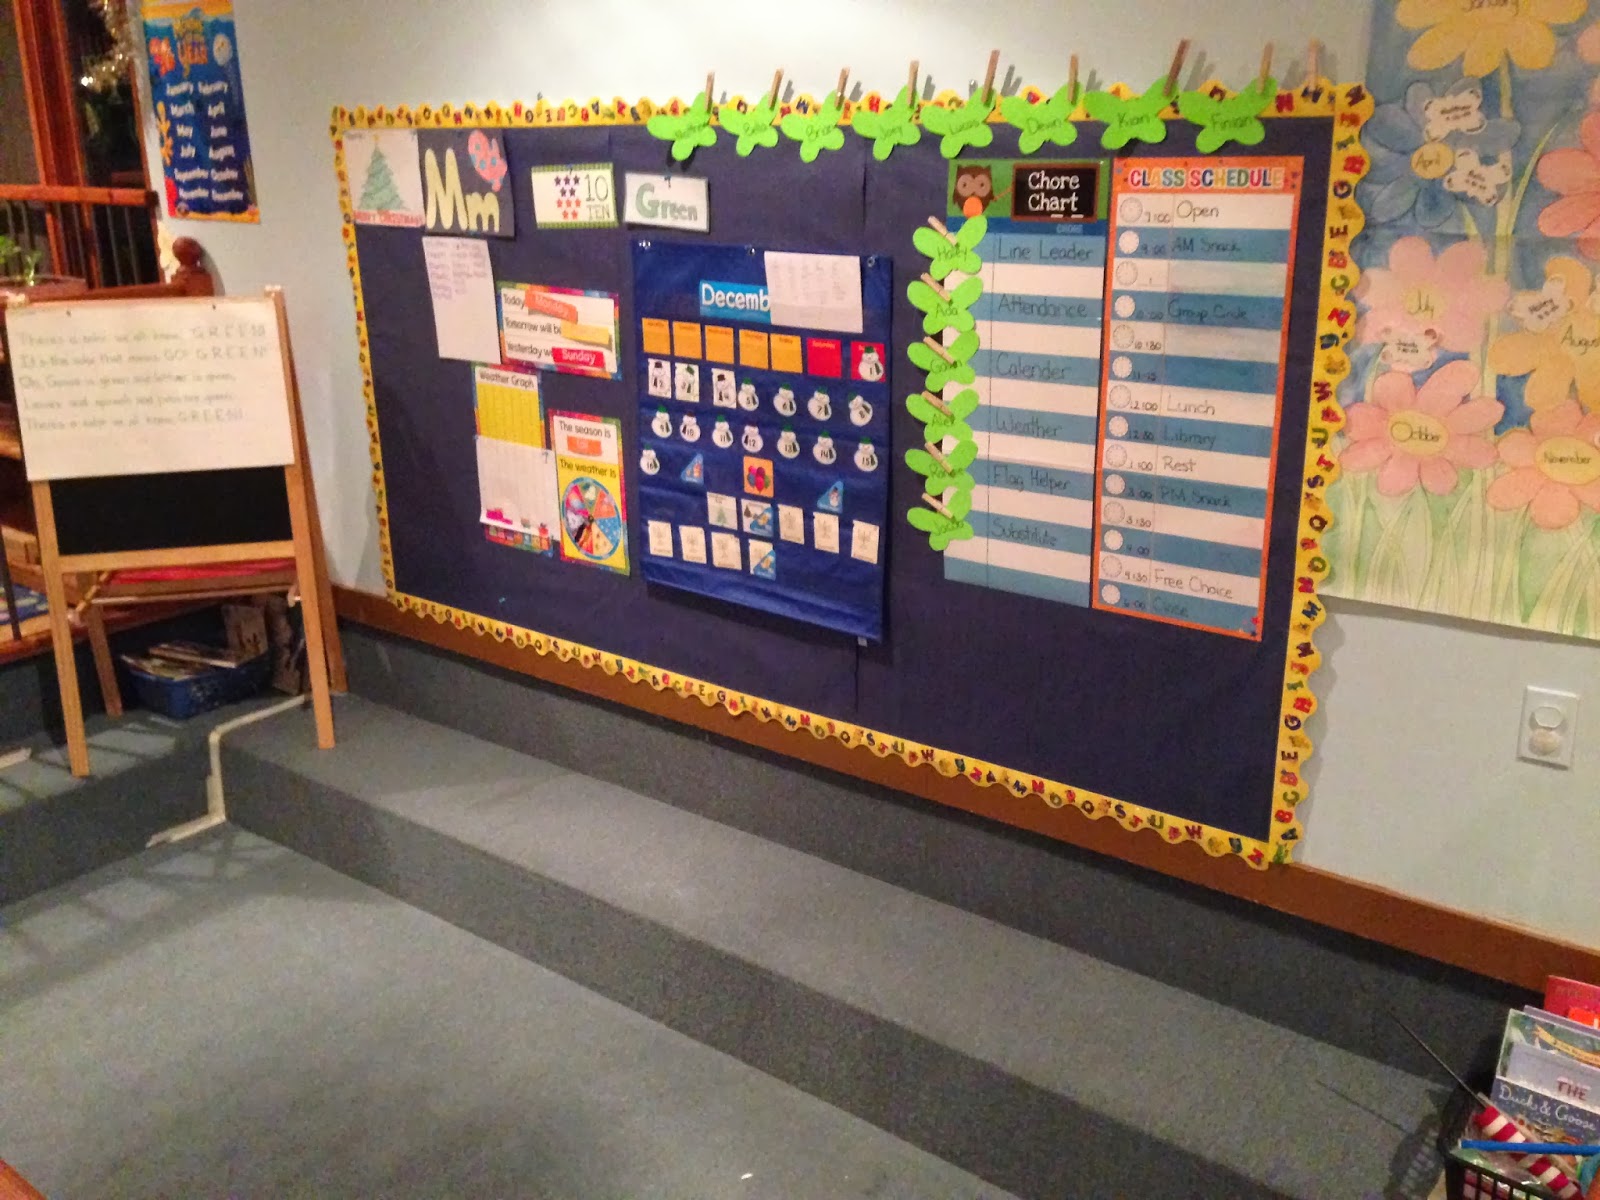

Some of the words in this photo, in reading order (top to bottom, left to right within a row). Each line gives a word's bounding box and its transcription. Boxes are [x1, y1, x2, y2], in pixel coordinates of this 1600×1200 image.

[1416, 152, 1441, 172] April
[584, 173, 609, 202] 10
[1028, 169, 1081, 190] Chore
[1129, 167, 1187, 189] CLASS
[1189, 166, 1286, 189] SCHEDULE
[635, 182, 699, 222] Green
[1028, 191, 1080, 212] Chart
[1176, 199, 1220, 224] Open
[587, 204, 611, 222] TEN
[998, 237, 1031, 261] Line
[1039, 239, 1094, 261] Leader
[1171, 237, 1195, 253] AM
[503, 293, 525, 310] Today
[999, 296, 1088, 318] Attendance
[1167, 299, 1208, 324] Group
[505, 317, 539, 333] Tomorrow
[540, 322, 552, 334] will
[507, 341, 543, 359] Yesterday
[561, 348, 597, 365] Sunday
[479, 371, 510, 386] Weather
[511, 374, 535, 389] Graph
[1166, 395, 1216, 416] Lunch
[559, 420, 573, 432] The
[574, 425, 603, 437] season
[604, 427, 612, 438] is
[995, 413, 1063, 438] Weather
[1390, 421, 1441, 443] October
[784, 444, 793, 453] 13
[560, 458, 573, 471] The
[575, 464, 608, 476] weather
[609, 468, 617, 478] is
[861, 456, 870, 466] 15
[1162, 455, 1197, 472] Rest
[1154, 568, 1184, 590] Free
[1189, 576, 1233, 600] Choice
[1557, 1078, 1590, 1101] THE
[1539, 1099, 1552, 1117] &
[1555, 1105, 1597, 1132] Goose
